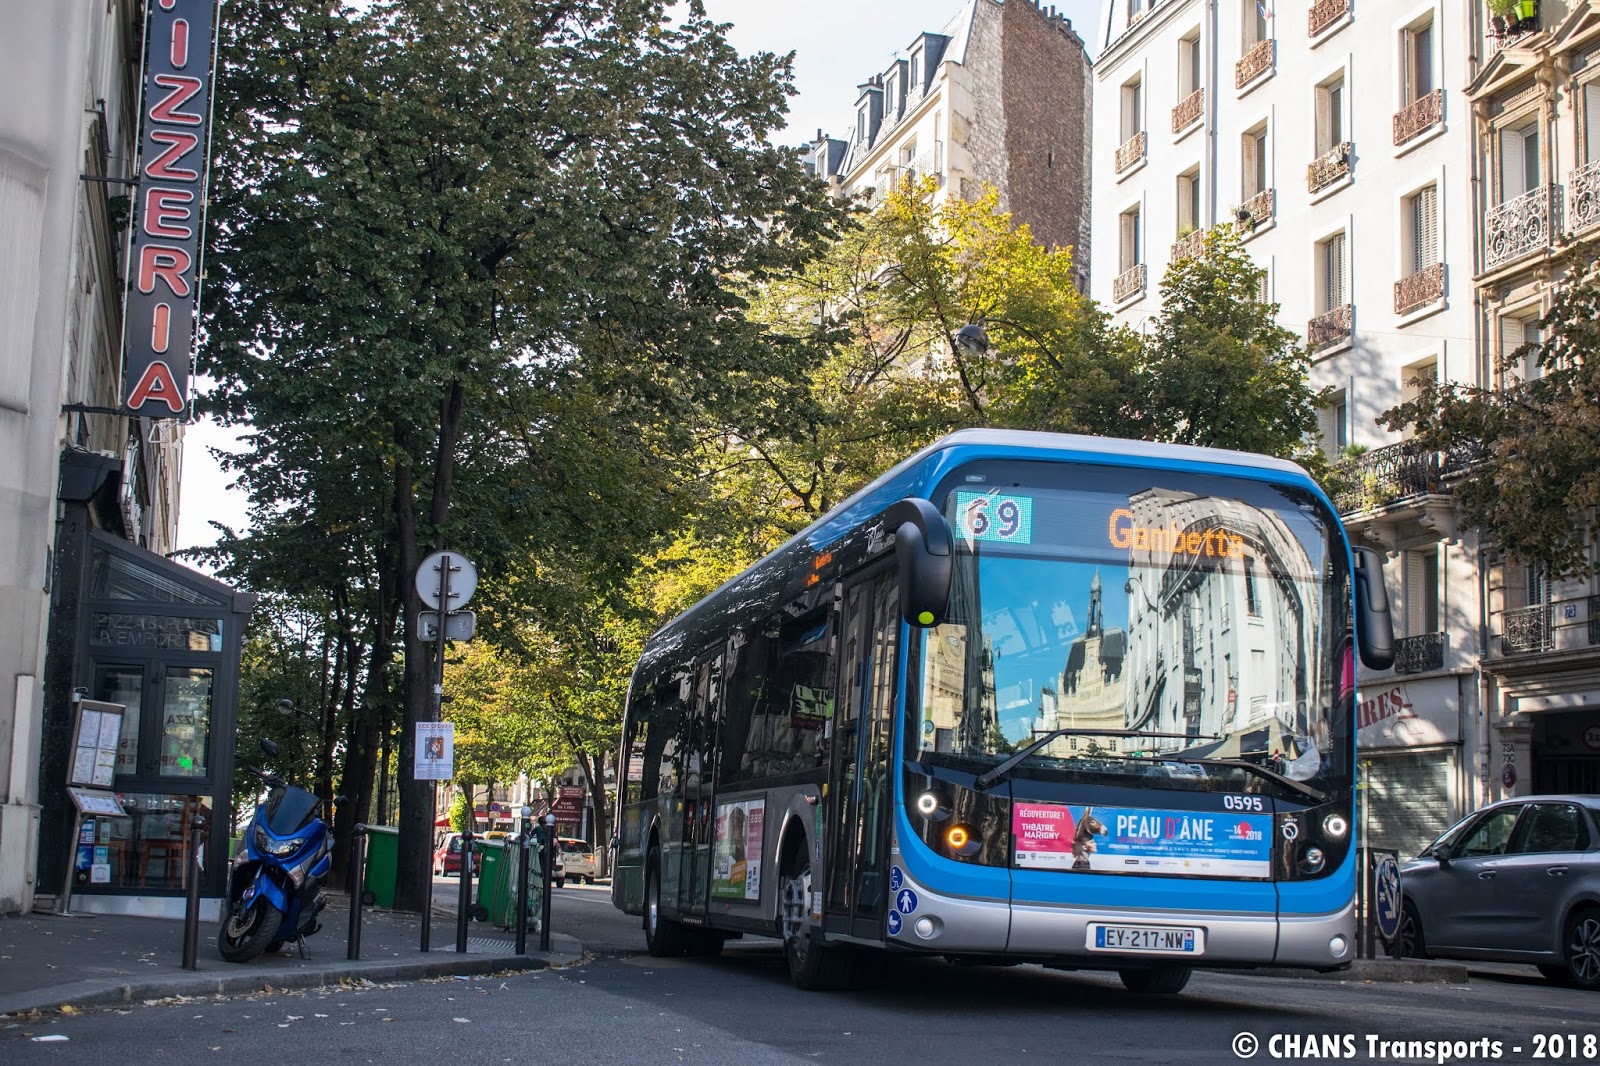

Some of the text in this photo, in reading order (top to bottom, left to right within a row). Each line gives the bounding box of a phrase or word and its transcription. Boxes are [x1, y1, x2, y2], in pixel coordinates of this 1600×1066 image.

[127, 0, 203, 413] IZZERIA
[965, 498, 1021, 538] 69
[1109, 508, 1244, 558] Gambetta
[117, 631, 191, 649] EMPORT
[1223, 795, 1263, 811] 0595
[1019, 808, 1061, 819] RÉOUVERTURE
[1024, 830, 1060, 840] MARIGNY
[1117, 815, 1161, 838] PEAU
[1233, 824, 1242, 835] 14
[1245, 830, 1262, 841] 2018
[1106, 929, 1184, 948] EY-217-NW
